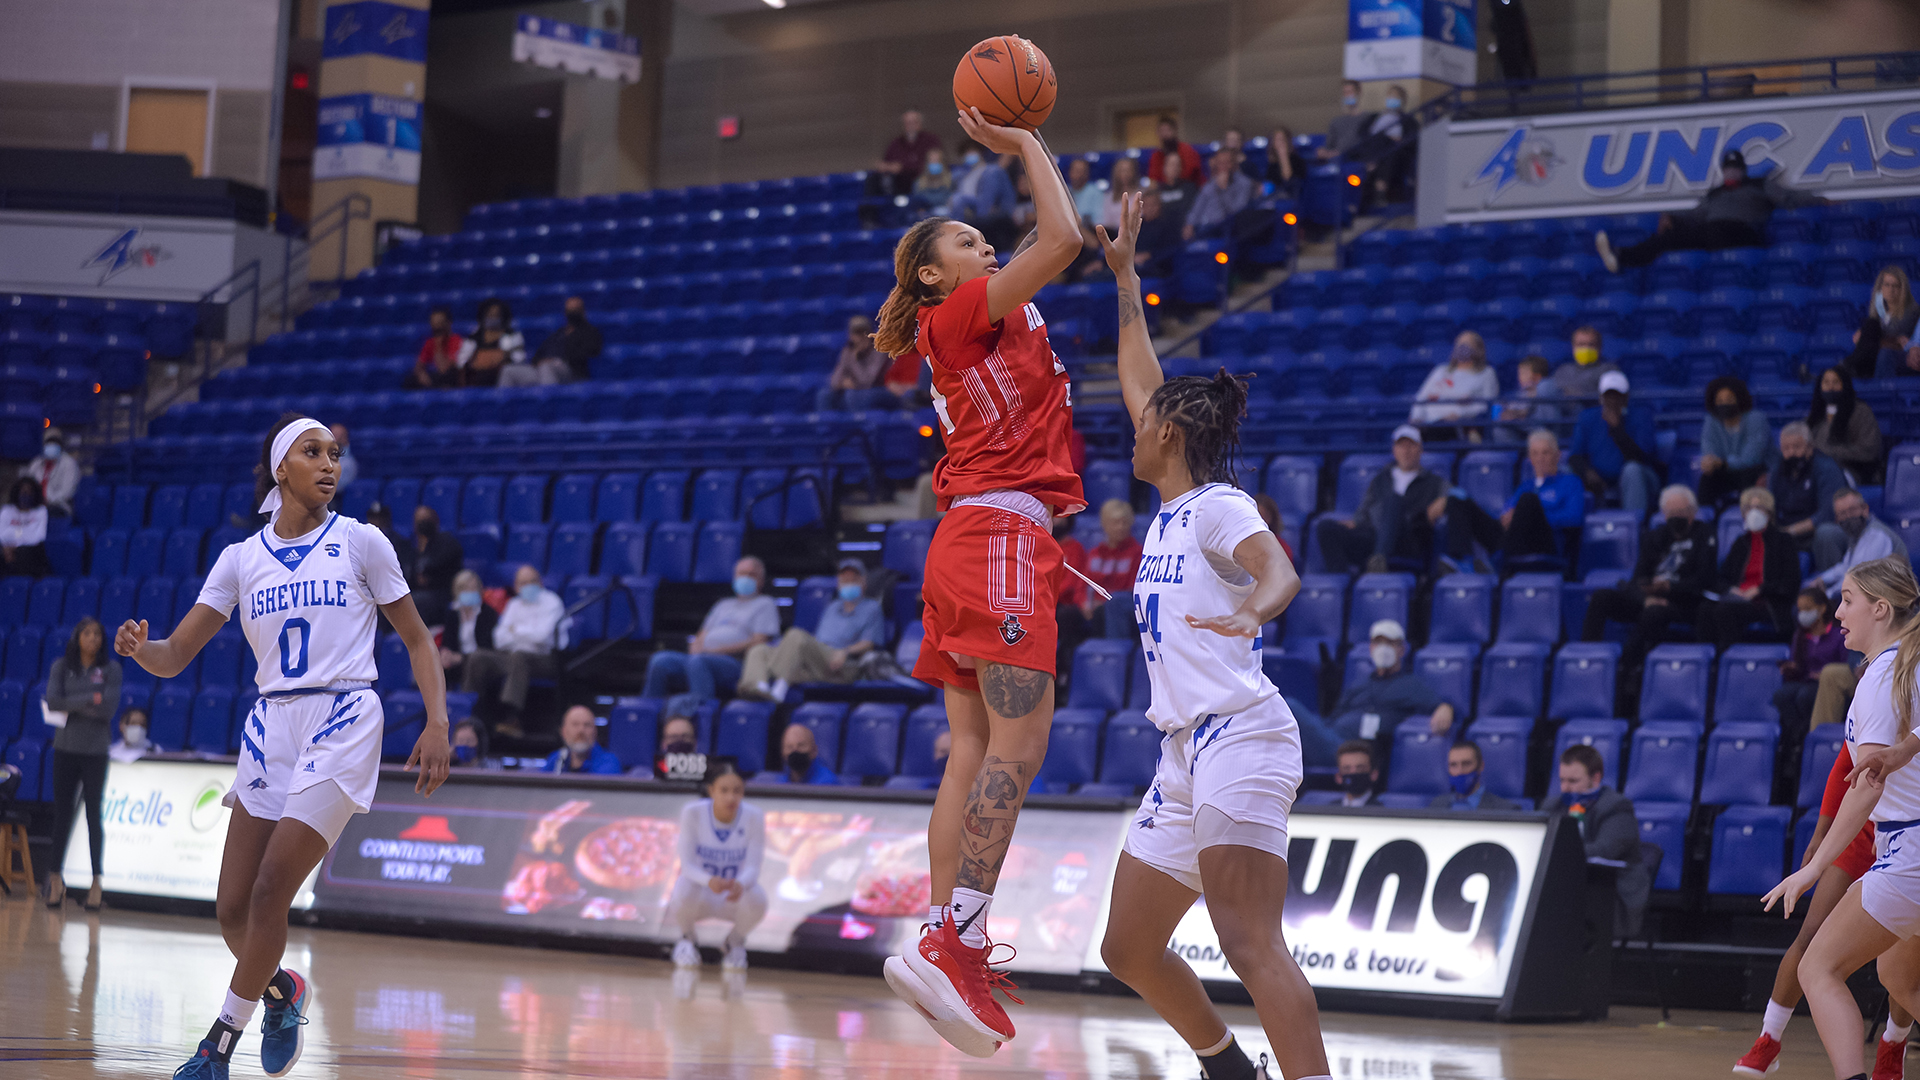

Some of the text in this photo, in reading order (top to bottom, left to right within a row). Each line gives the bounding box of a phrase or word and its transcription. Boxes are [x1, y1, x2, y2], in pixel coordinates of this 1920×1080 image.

[1583, 121, 1790, 190] UNC
[251, 580, 347, 621] ASHEVILLE
[278, 617, 311, 678] 0
[102, 788, 172, 827] irtelle
[1283, 837, 1520, 981] ung
[1343, 945, 1358, 971] &
[1368, 946, 1427, 975] tours
